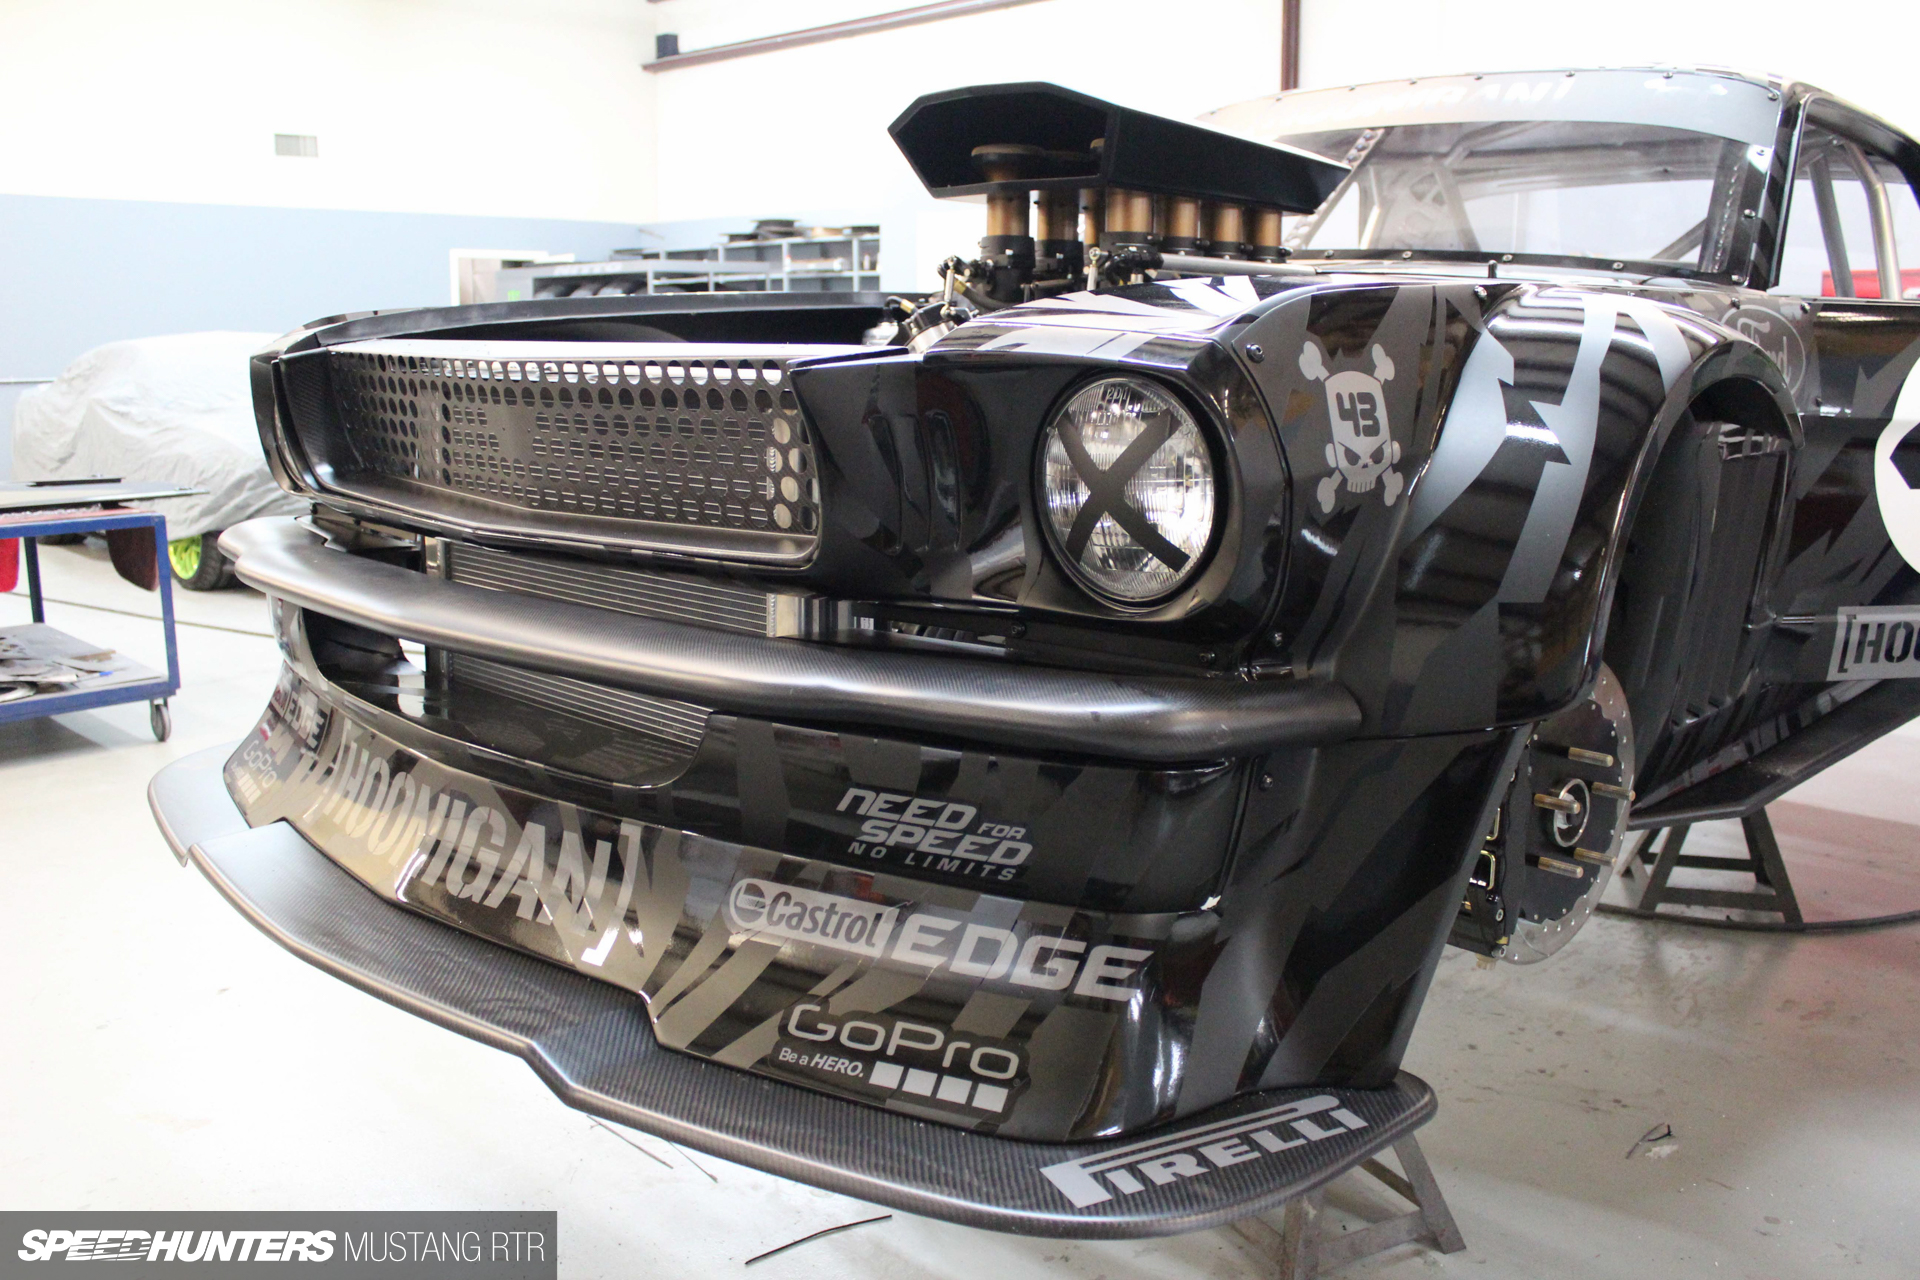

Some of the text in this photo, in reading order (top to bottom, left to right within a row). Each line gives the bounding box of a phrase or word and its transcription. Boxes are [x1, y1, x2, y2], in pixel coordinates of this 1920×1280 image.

[1335, 391, 1381, 438] 43
[1837, 614, 1920, 673] [HO
[243, 739, 277, 789] GoPro
[836, 787, 1026, 840] NEED FOR
[848, 842, 1017, 881] NO LIMITS
[855, 819, 1033, 866] SPEED
[766, 891, 1155, 1002] Castrol EDGE
[778, 1047, 864, 1078] Be a HERO.
[787, 1004, 1019, 1080] GoPro
[1039, 1095, 1369, 1209] PIRELLI
